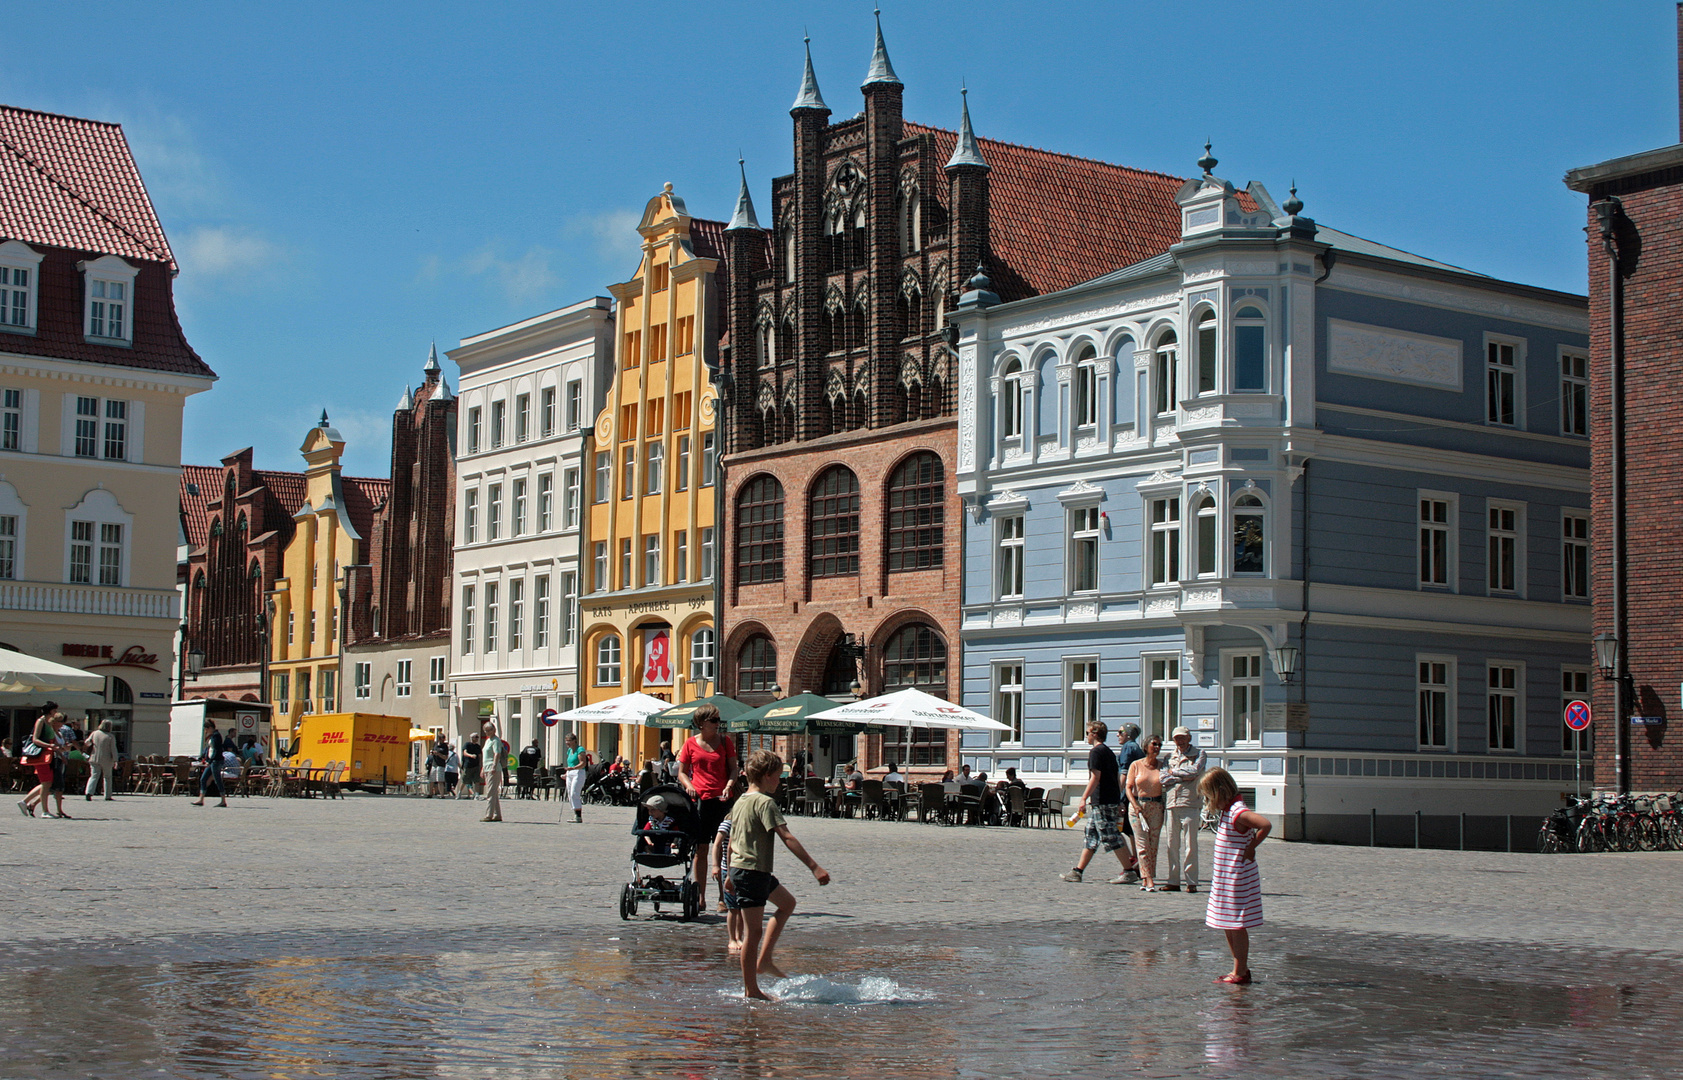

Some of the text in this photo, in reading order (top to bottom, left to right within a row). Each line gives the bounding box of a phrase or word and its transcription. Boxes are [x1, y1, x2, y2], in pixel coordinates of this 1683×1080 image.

[592, 595, 706, 618] RATS APOTHEKE 1998
[321, 732, 344, 744] DHL
[362, 733, 400, 745] DHL
